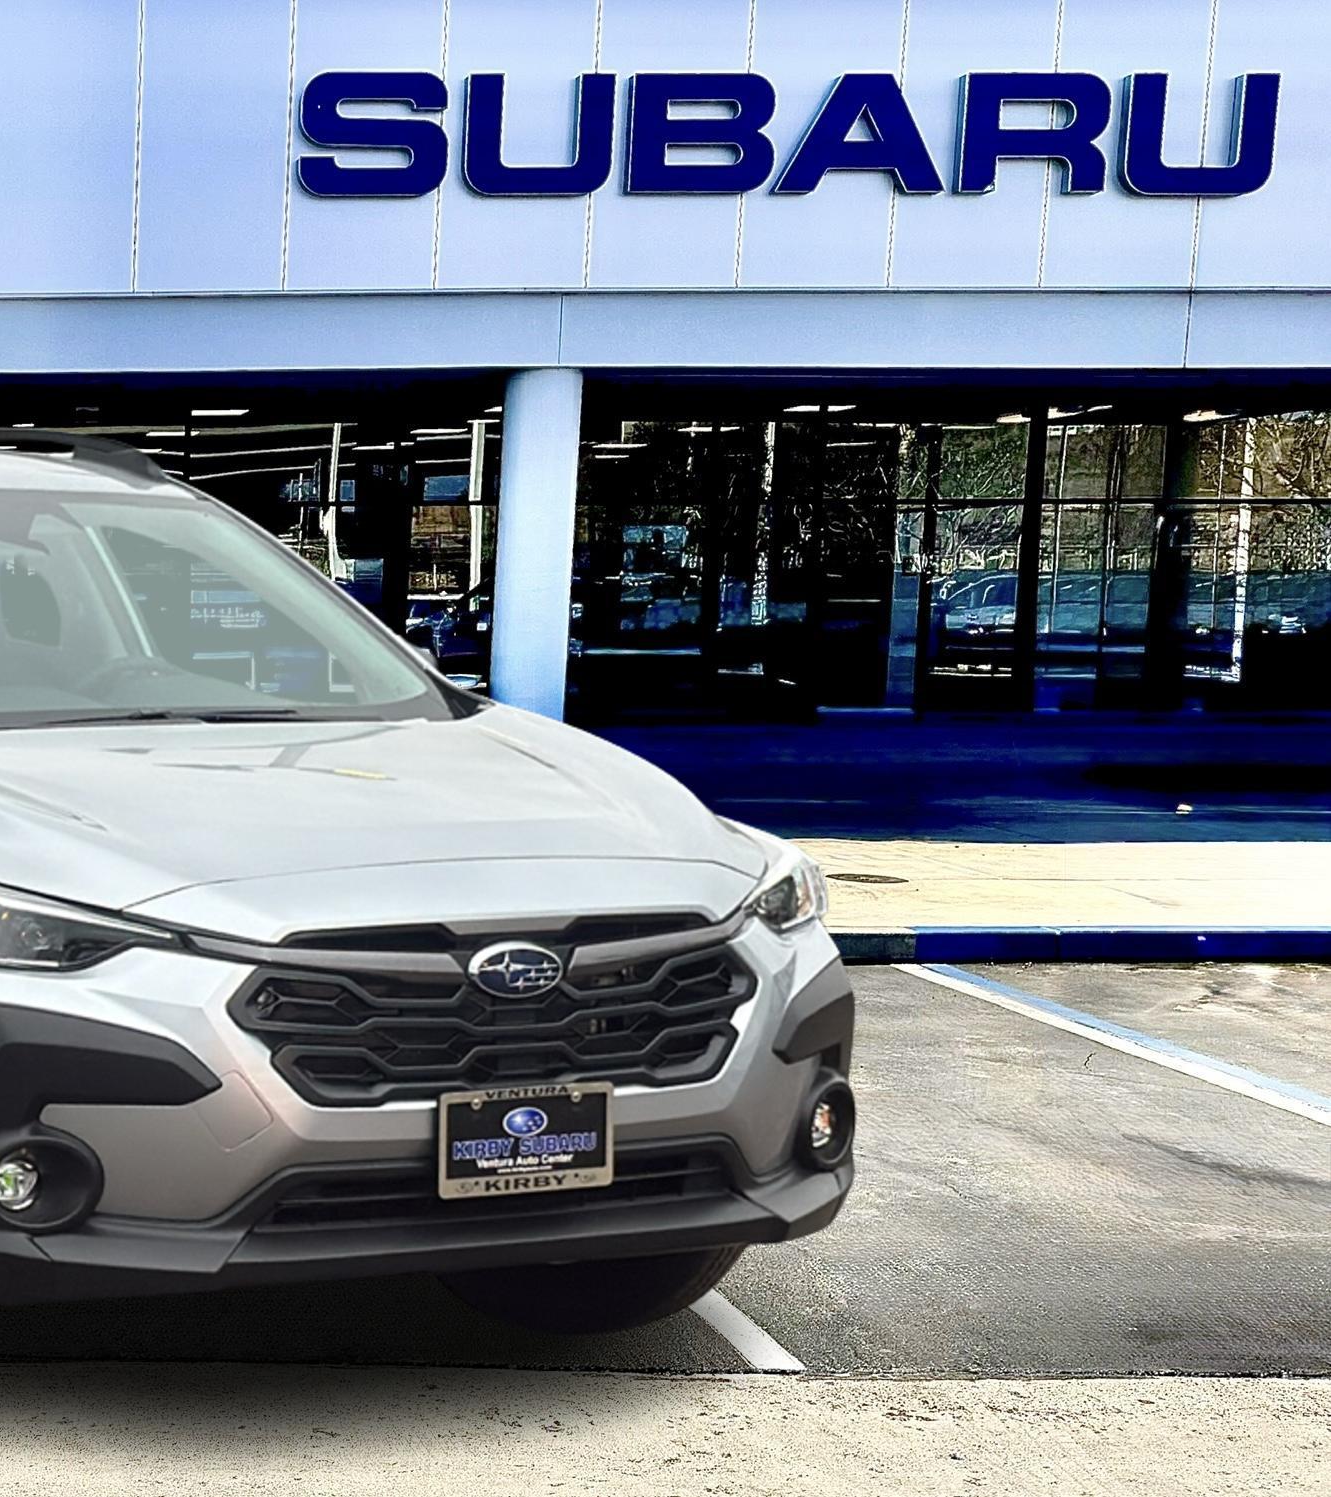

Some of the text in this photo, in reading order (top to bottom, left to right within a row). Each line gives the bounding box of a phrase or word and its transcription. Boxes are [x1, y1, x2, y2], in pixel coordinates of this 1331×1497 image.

[298, 70, 1282, 198] SUBARU
[485, 1086, 569, 1099] VENTURA
[453, 1132, 597, 1160] KIRBY SUBARU
[476, 1154, 574, 1169] Ventura Auto Center
[484, 1174, 567, 1192] KIRBY
